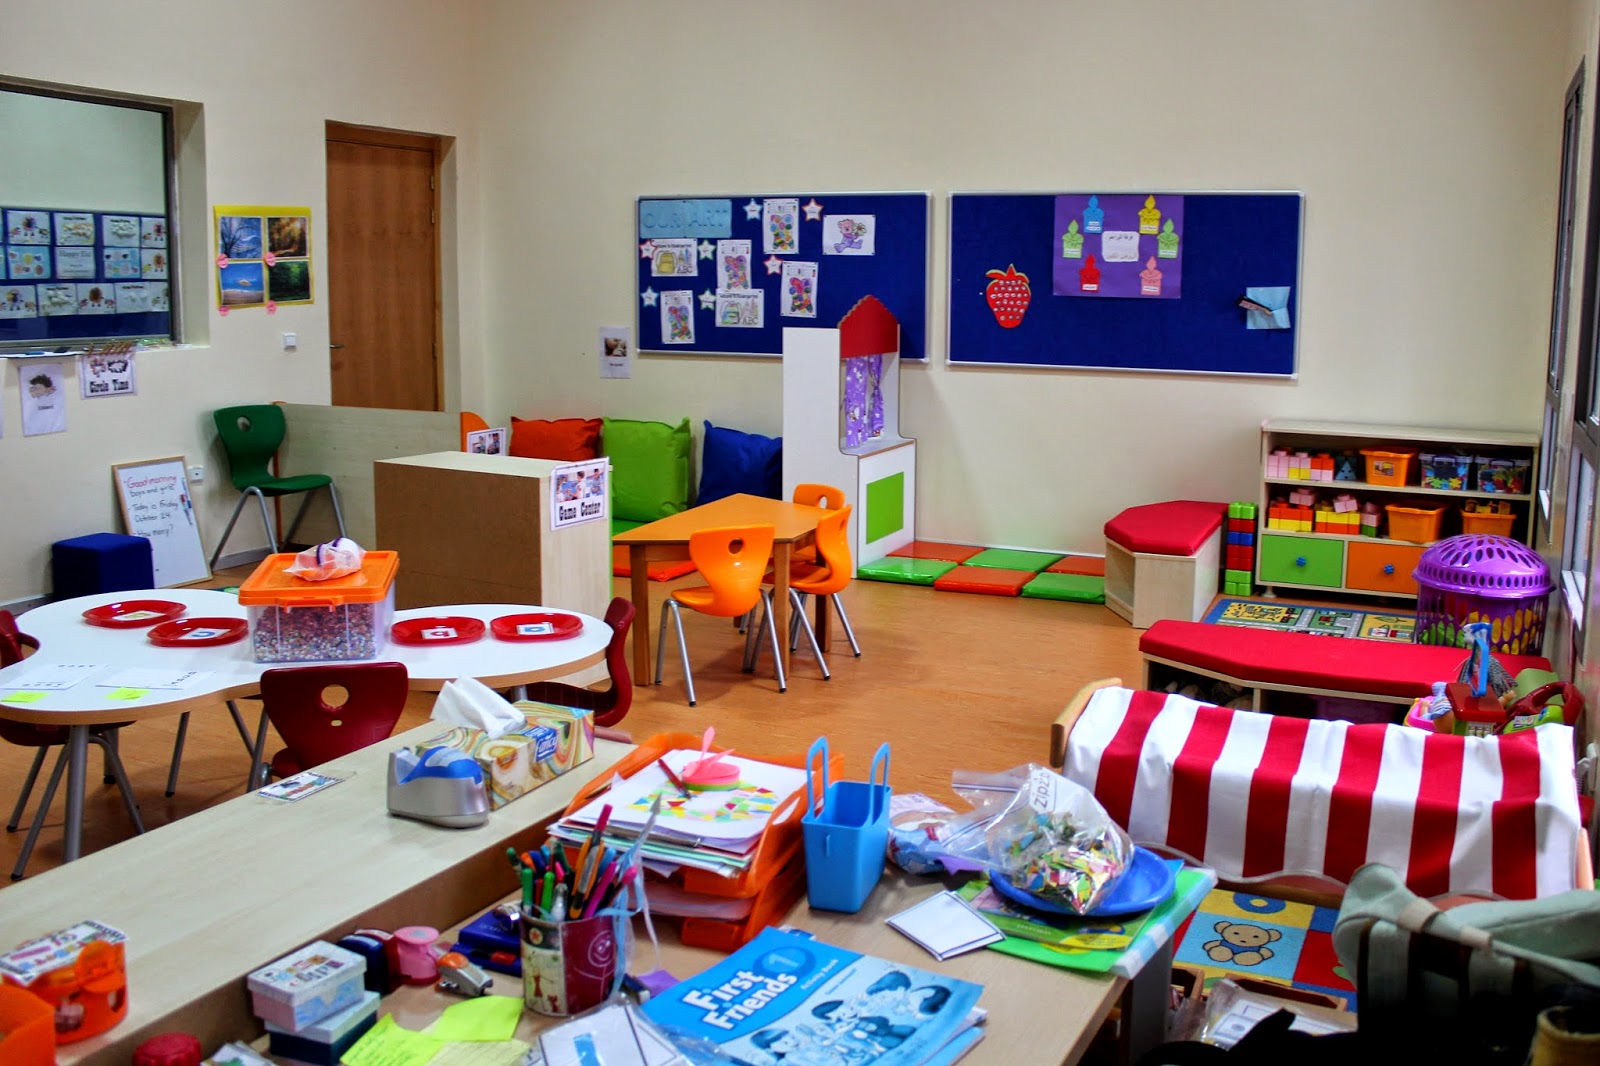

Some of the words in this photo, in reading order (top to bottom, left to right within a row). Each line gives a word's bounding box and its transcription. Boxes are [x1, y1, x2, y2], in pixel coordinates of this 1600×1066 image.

[643, 212, 682, 229] OUR
[688, 209, 728, 228] ART
[676, 263, 692, 274] ABC
[742, 316, 758, 325] ABC
[89, 380, 109, 393] Circle
[112, 378, 129, 391] Time
[126, 475, 148, 489] Good
[148, 474, 177, 487] morning
[130, 488, 146, 498] boys
[146, 486, 158, 494] and
[133, 503, 149, 513] Today
[159, 499, 179, 510] Friday
[558, 505, 577, 521] Game
[580, 501, 601, 518] Center
[134, 513, 158, 523] October
[160, 512, 171, 520] 24
[768, 953, 800, 968] 1
[681, 970, 765, 1011] First
[701, 972, 798, 1030] Friends
